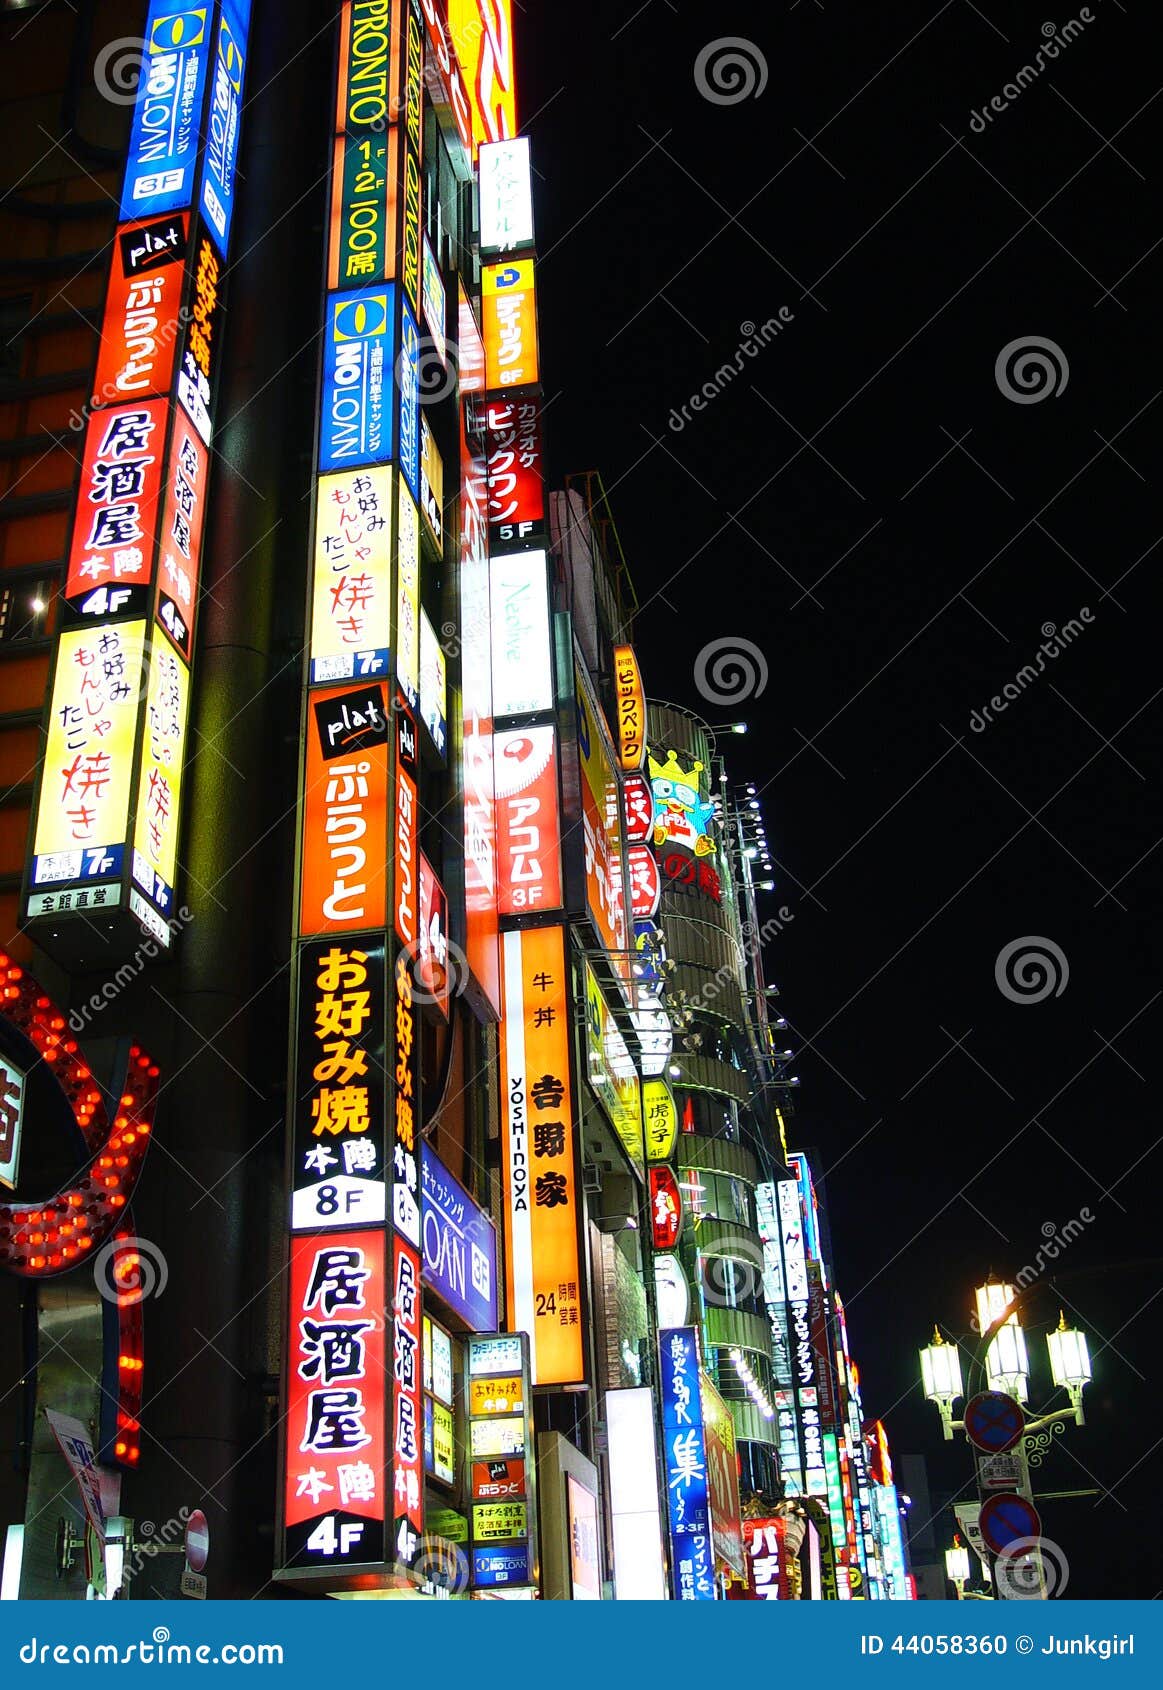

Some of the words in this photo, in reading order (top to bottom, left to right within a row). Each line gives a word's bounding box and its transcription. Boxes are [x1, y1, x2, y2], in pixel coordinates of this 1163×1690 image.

[350, 0, 389, 125] PRONTO
[137, 53, 178, 163] NOLOAN
[138, 173, 179, 195] 3F
[130, 228, 178, 266] plat
[115, 277, 165, 391] ぷらっと
[496, 294, 525, 366] ディック
[331, 341, 363, 458] NOLOAN
[500, 369, 524, 385] 6F
[487, 403, 519, 523] ビックワン
[518, 403, 539, 468] カラオケ
[88, 410, 156, 550] 居酒屋
[352, 475, 386, 532] お好み
[331, 489, 371, 560] もんじゃ
[500, 521, 533, 540] 5F
[79, 546, 143, 579] 本陣
[322, 535, 350, 572] たこ
[82, 587, 132, 615] 4F
[160, 601, 186, 641] 4F
[329, 573, 374, 643] 焼き
[98, 632, 131, 701] お好み
[357, 651, 384, 675] 7F
[74, 648, 112, 737] もんじゃ
[619, 670, 639, 757] ピックペック
[59, 704, 87, 750] たこ
[328, 700, 380, 746] plat
[61, 751, 111, 840] 焼き
[85, 847, 115, 875] 7F
[322, 762, 371, 920] ぷらっと
[398, 774, 413, 942] ぷらっと
[508, 797, 543, 883] アコム
[41, 887, 108, 913] 全館直営
[511, 886, 543, 907] 3F
[532, 972, 556, 1029] 牛丼
[312, 948, 370, 1137] お好み焼
[396, 957, 414, 1152] お好み焼
[511, 1077, 528, 1212] YOSHINOYA
[531, 1074, 568, 1208] 吉野家
[648, 1104, 671, 1143] 虎の子
[304, 1137, 377, 1175] 本陣
[650, 1148, 664, 1157] 4F
[315, 1184, 363, 1216] 8F
[422, 1161, 465, 1223] キャッシング
[423, 1210, 466, 1300] OAN
[536, 1294, 556, 1316] 24
[298, 1247, 376, 1453] 居酒屋
[394, 1251, 418, 1463] 居酒屋
[296, 1463, 375, 1505] 本陣
[478, 1482, 519, 1495] ぷらっと
[307, 1516, 364, 1555] 4F
[396, 1519, 417, 1562] 4F
[693, 1535, 710, 1592] ワインと
